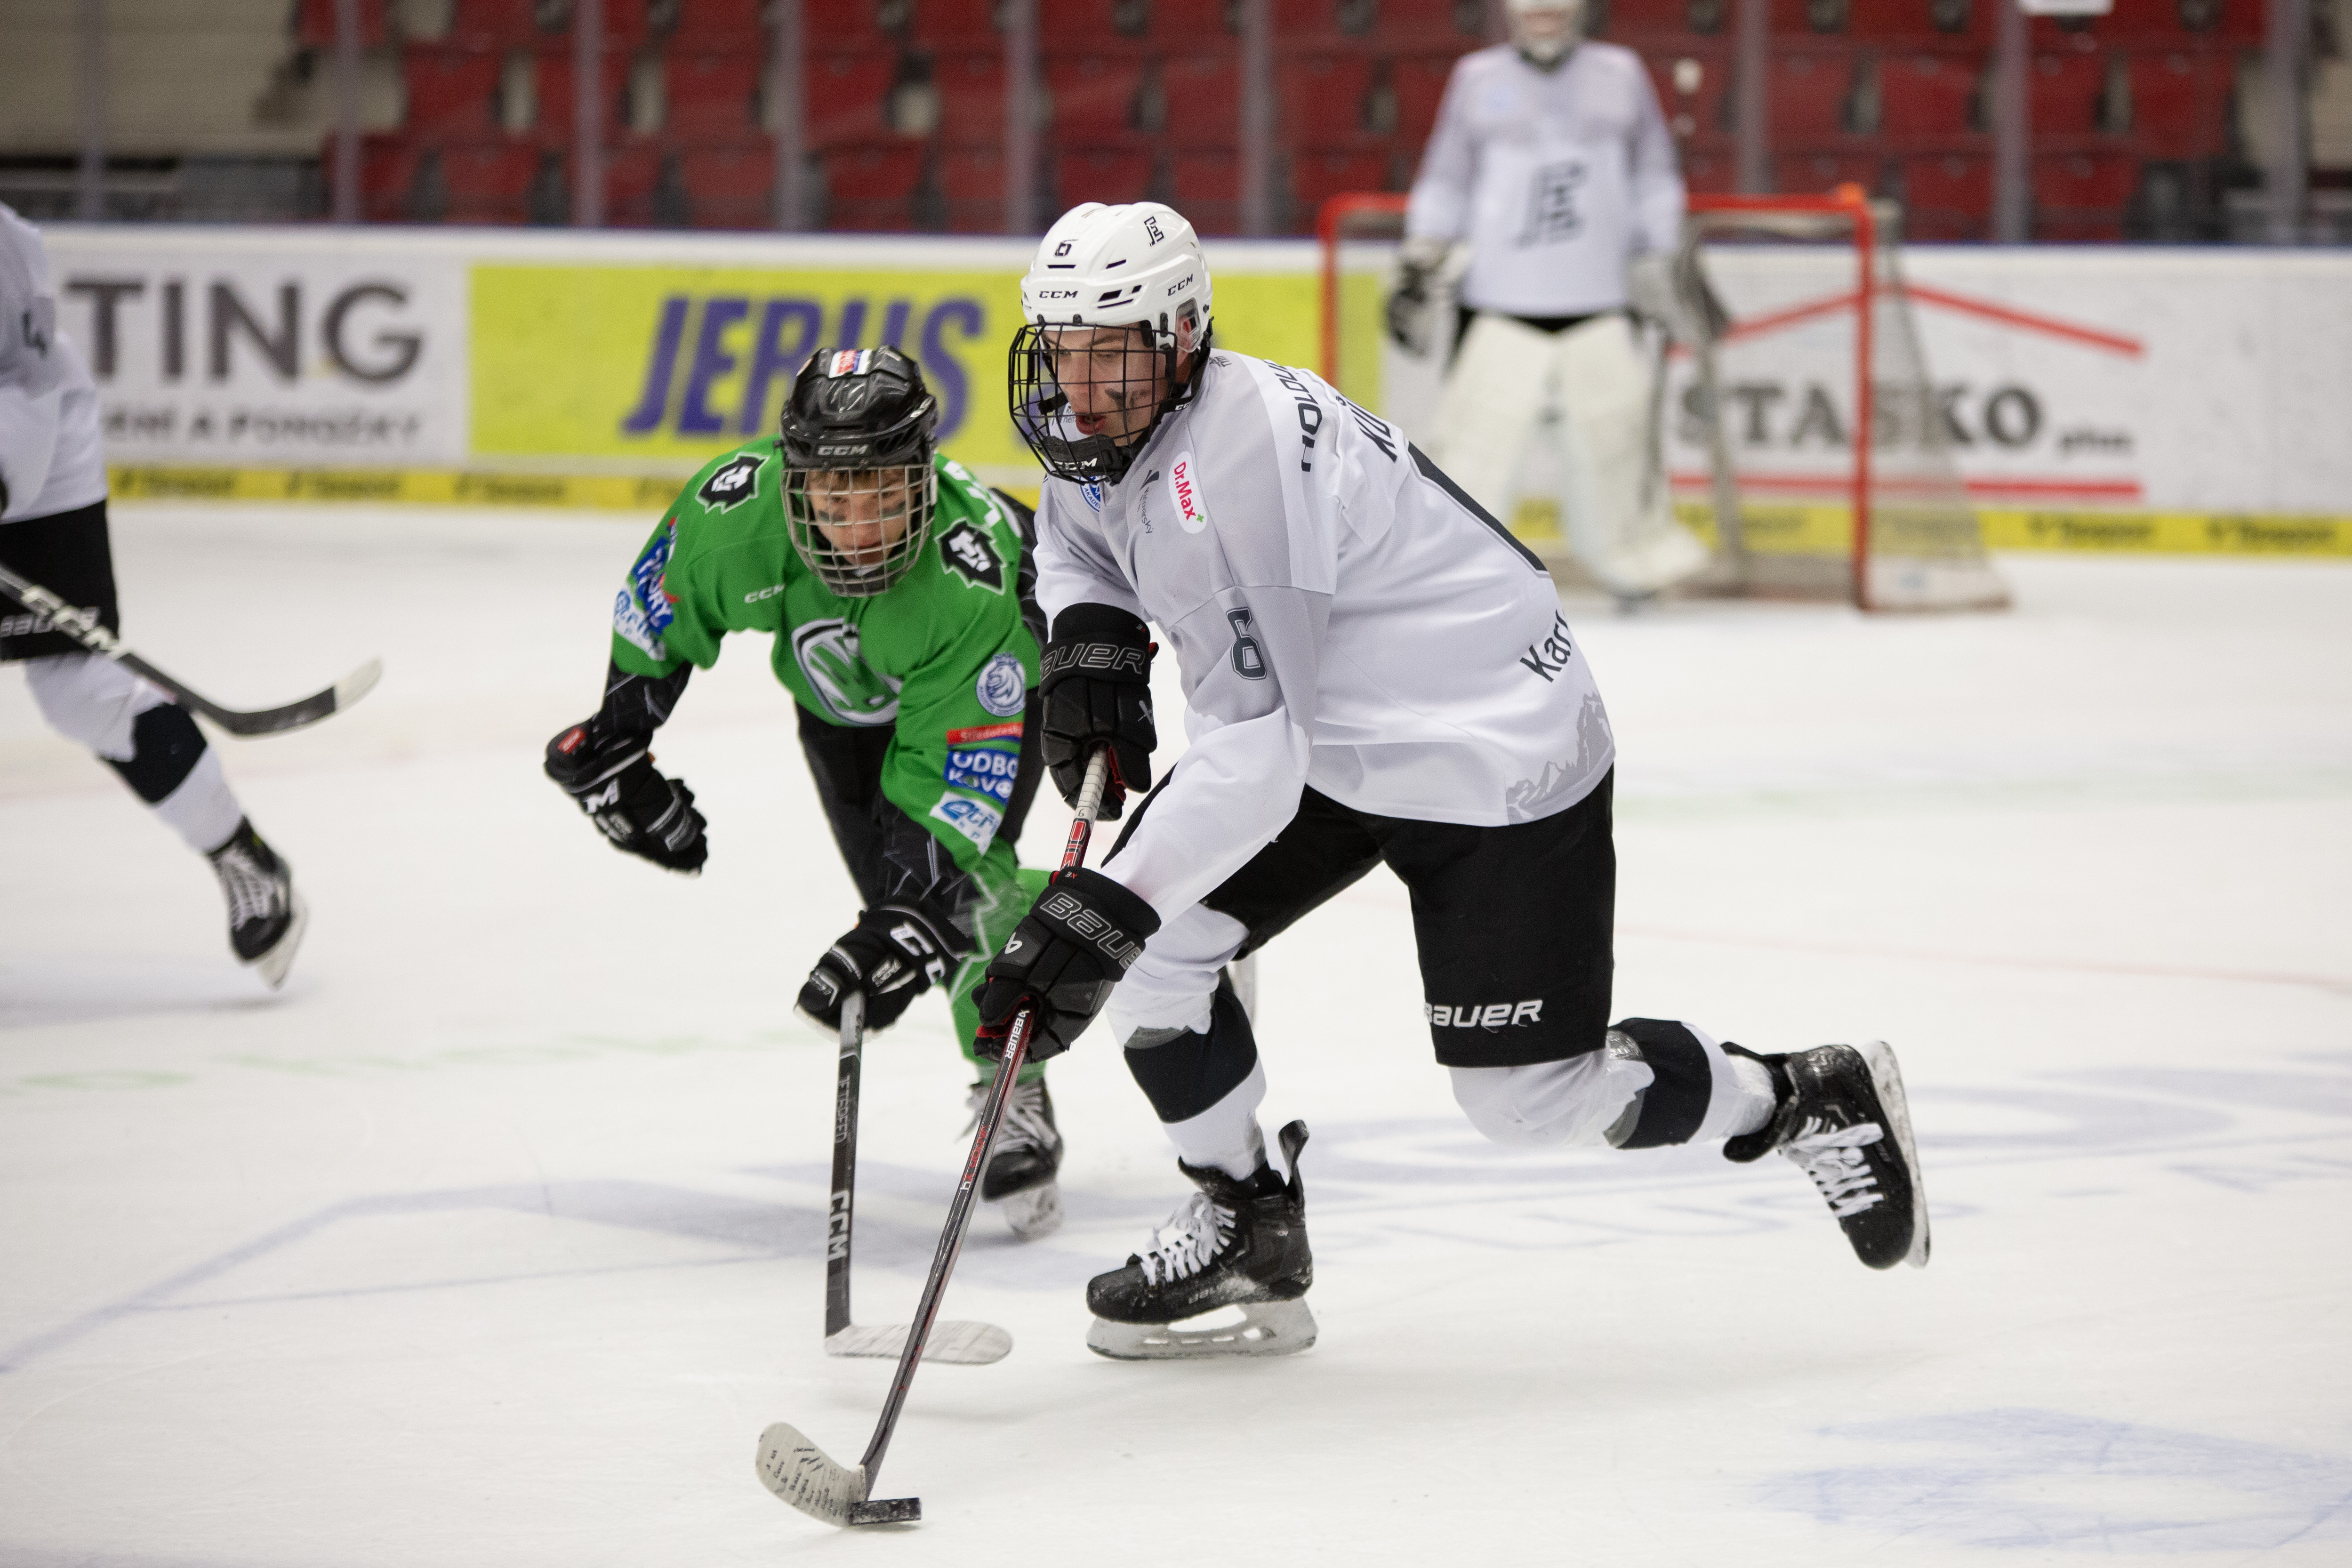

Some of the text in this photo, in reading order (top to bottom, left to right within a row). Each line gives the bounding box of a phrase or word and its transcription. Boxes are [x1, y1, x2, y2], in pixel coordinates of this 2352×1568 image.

[1039, 290, 1078, 299] CCM
[1167, 274, 1193, 296] CCM
[817, 445, 869, 456] CCM
[1174, 461, 1196, 521] Dr.Max
[1226, 606, 1267, 680] 6
[1006, 1017, 1024, 1060] BAUER
[827, 1190, 850, 1262] CCM
